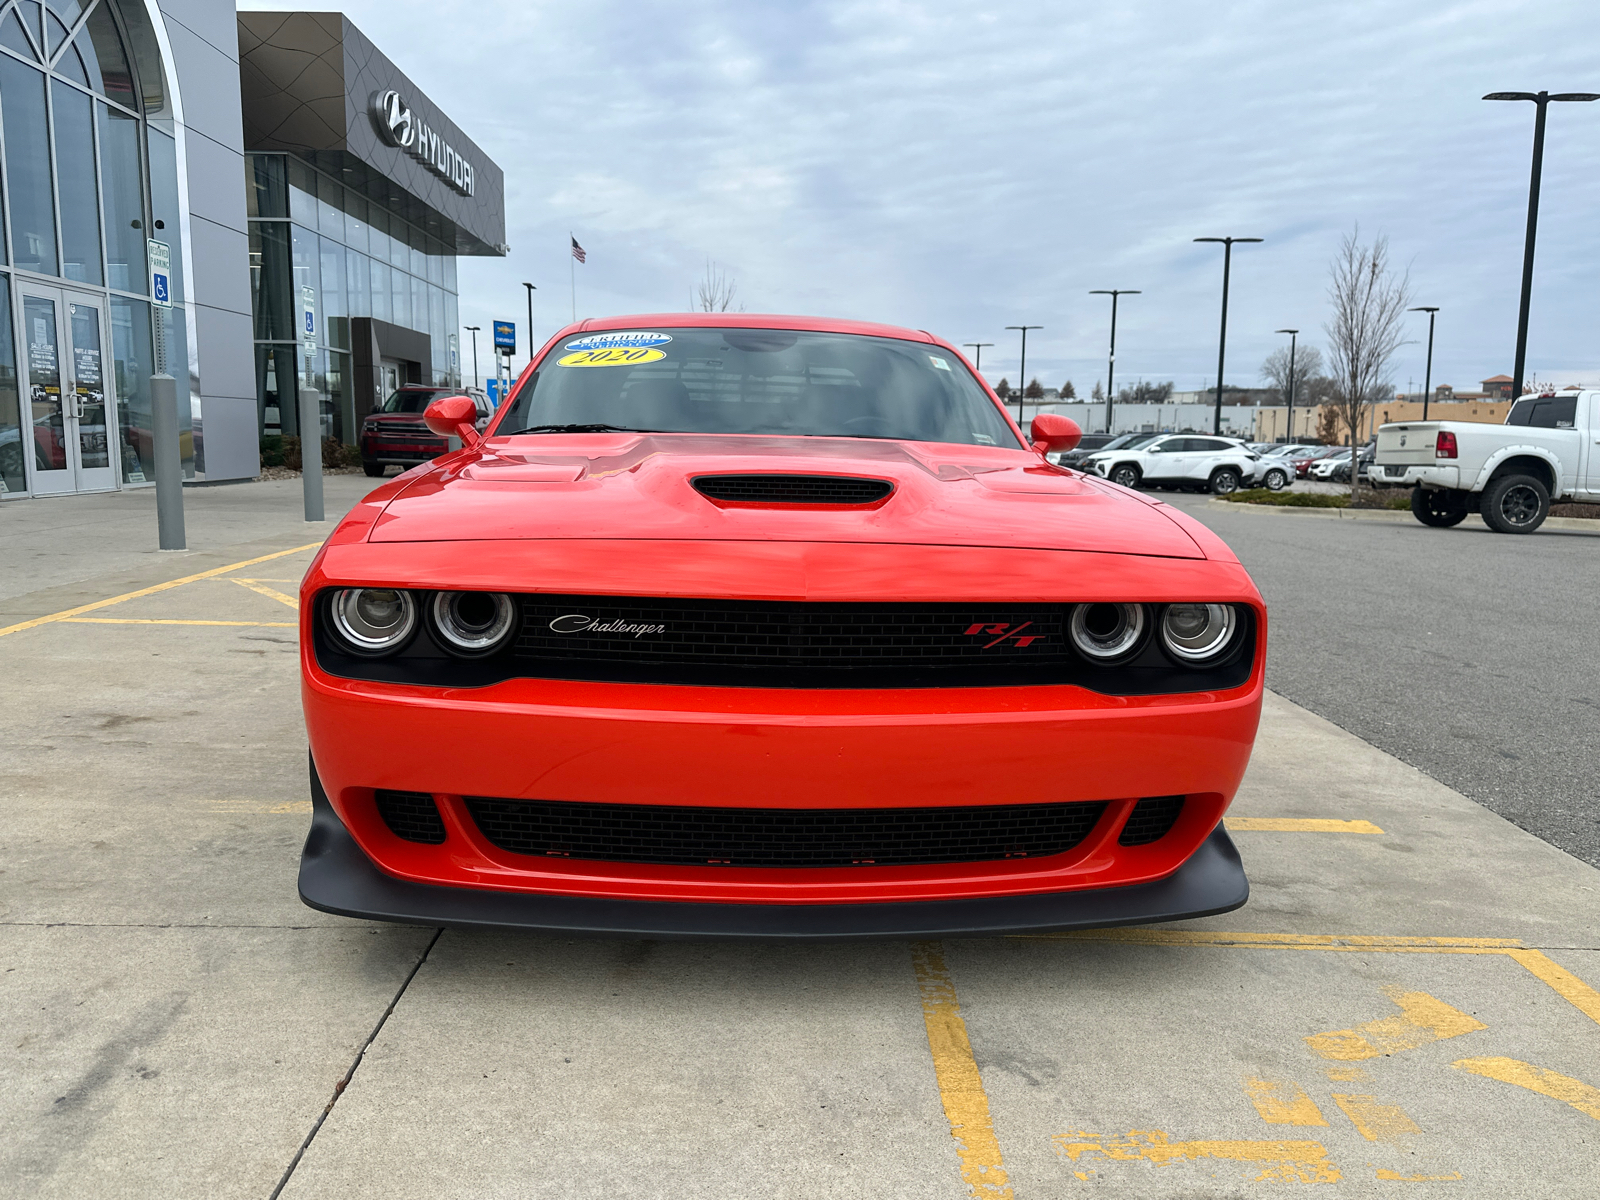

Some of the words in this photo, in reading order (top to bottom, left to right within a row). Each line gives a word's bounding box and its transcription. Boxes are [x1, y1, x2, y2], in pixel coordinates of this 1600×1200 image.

[417, 118, 475, 197] HYUNDAI
[150, 245, 169, 259] RESERVED
[151, 256, 169, 269] PARKING
[579, 333, 662, 344] CERTIFIED
[569, 349, 649, 365] 2020
[549, 614, 665, 638] Challenger
[963, 621, 1046, 649] R/T
